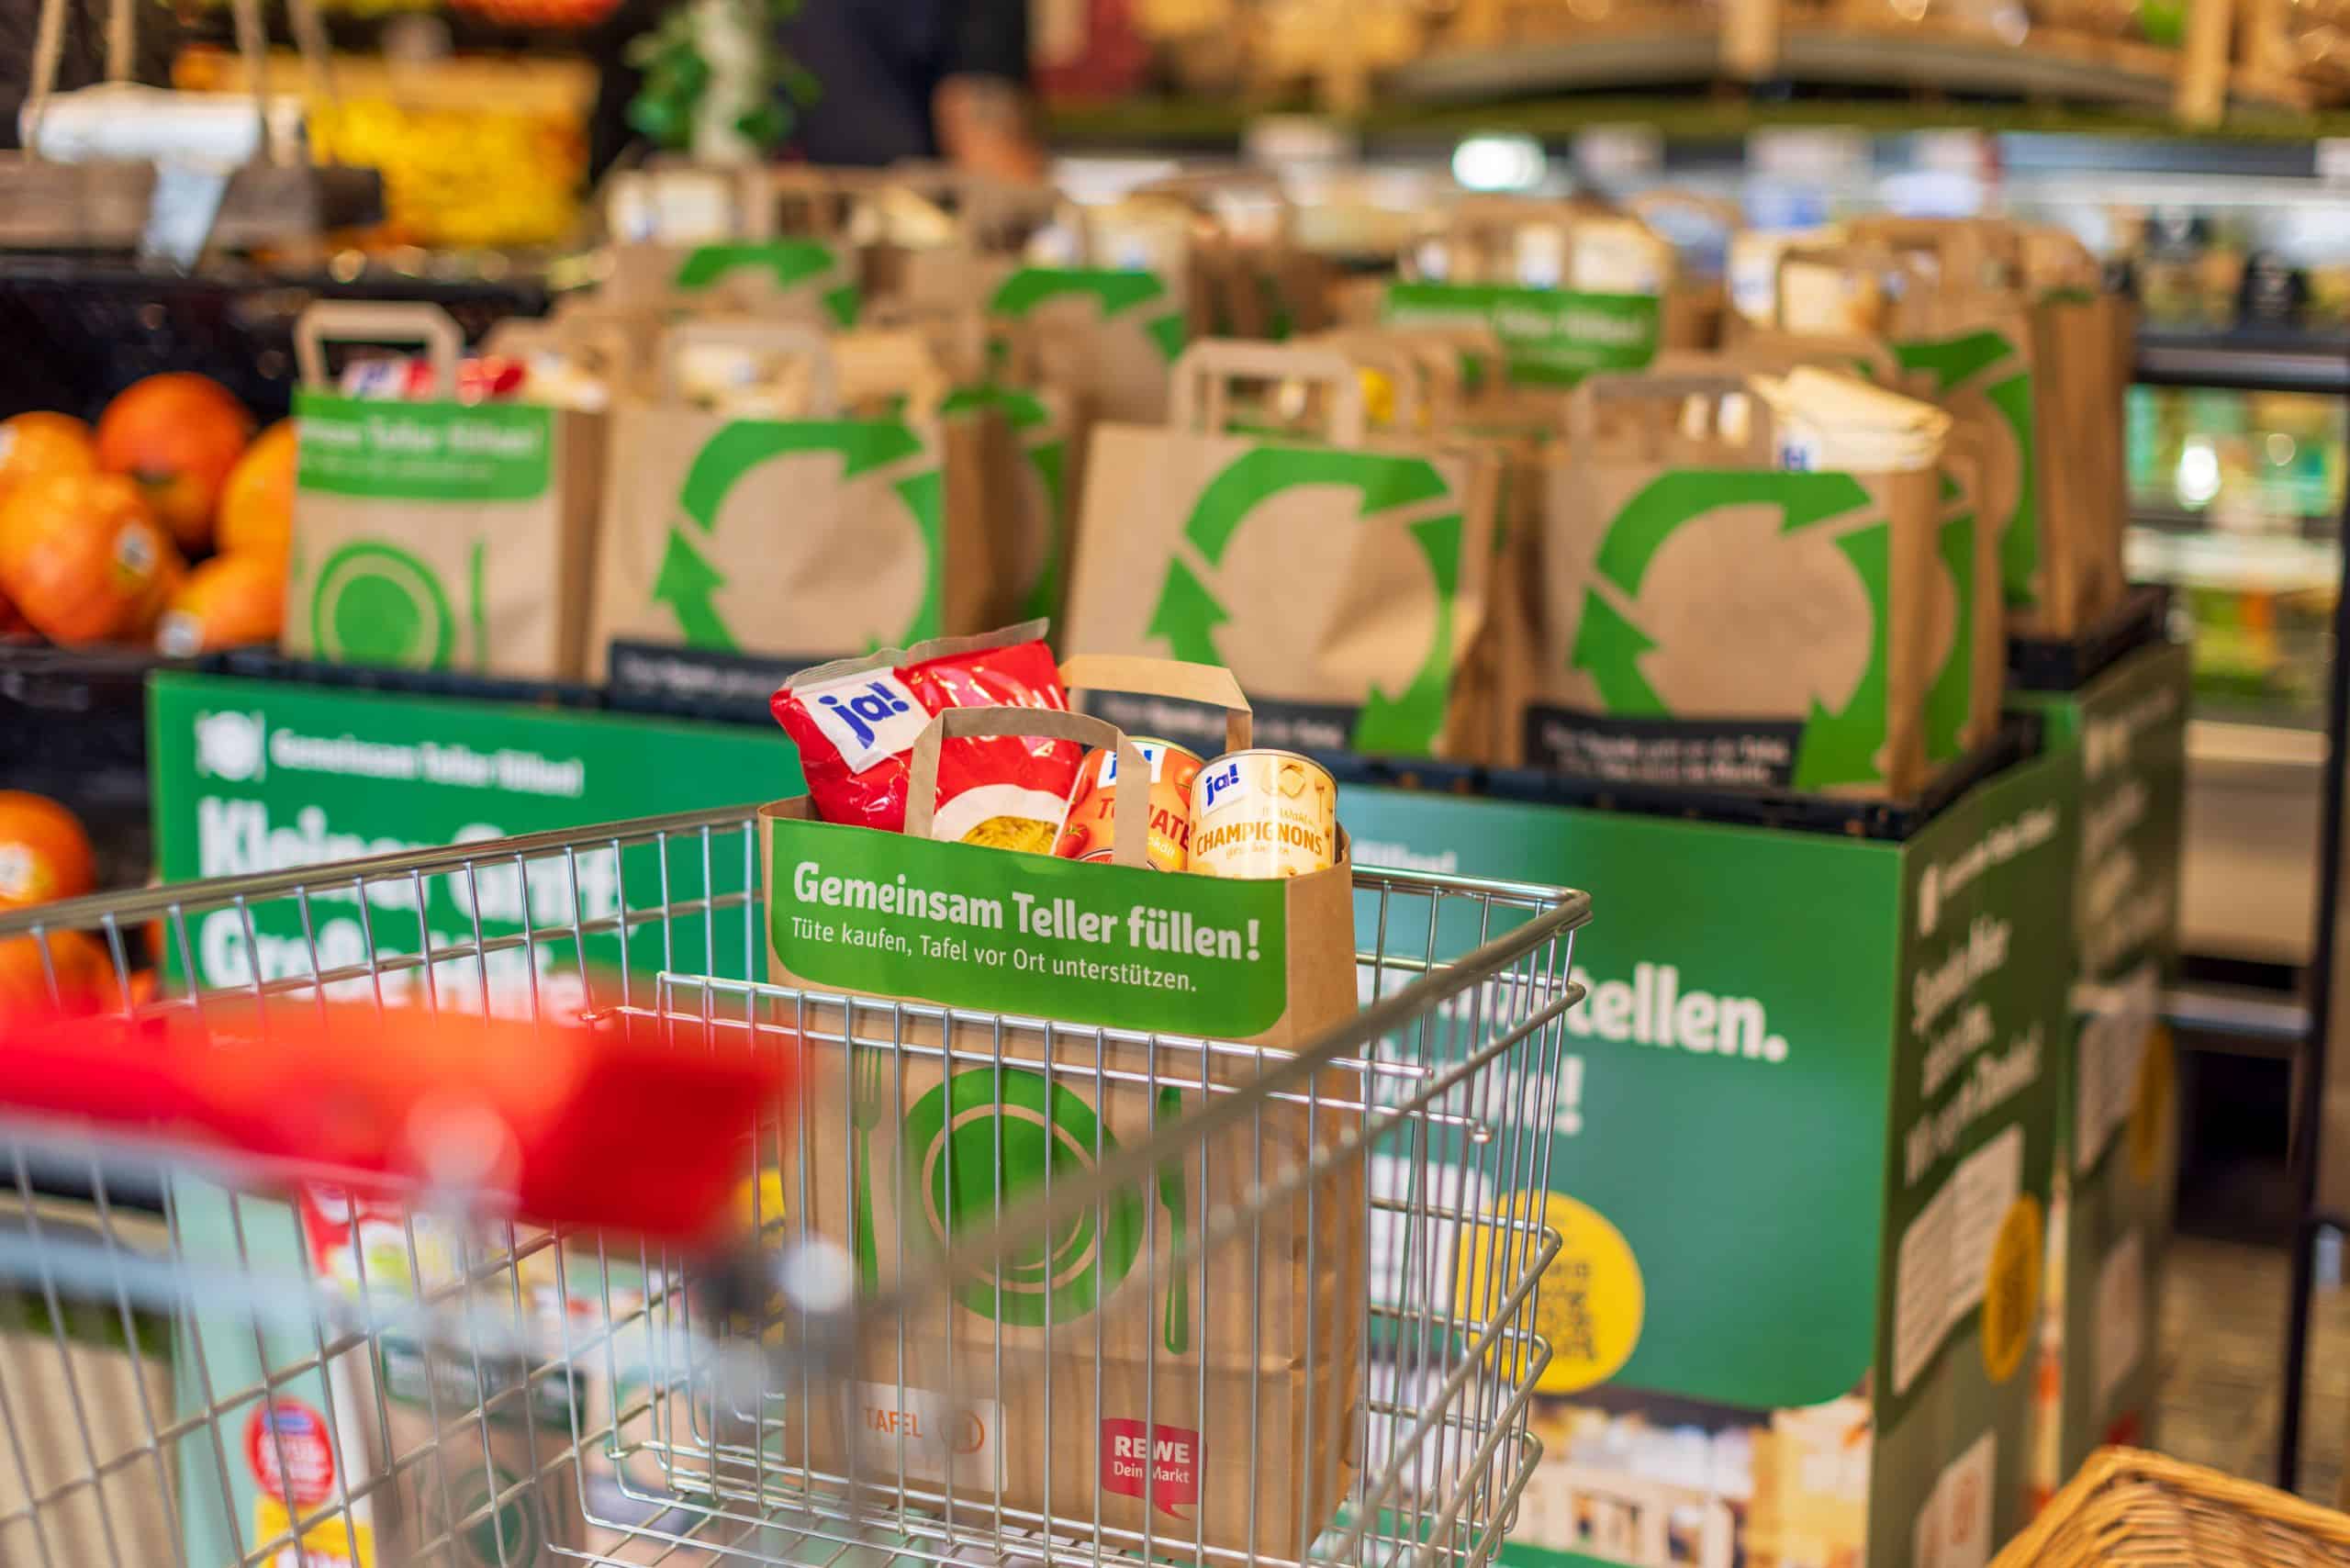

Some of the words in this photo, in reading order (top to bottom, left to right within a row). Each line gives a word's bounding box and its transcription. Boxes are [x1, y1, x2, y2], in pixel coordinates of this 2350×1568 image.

[818, 681, 910, 749] ja!
[1205, 764, 1239, 806] ja!
[794, 861, 1003, 929] Gemeinsam
[1012, 891, 1118, 944] Teller
[1127, 905, 1260, 961] füllen!
[791, 916, 834, 942] Tüte
[842, 923, 912, 957] kaufen,
[920, 935, 968, 962] Tafel
[974, 947, 1006, 967] vor
[1013, 948, 1046, 973] Ort
[1053, 956, 1197, 992] unterstützen.
[1113, 1435, 1191, 1464] REWE
[1113, 1461, 1144, 1479] Dein
